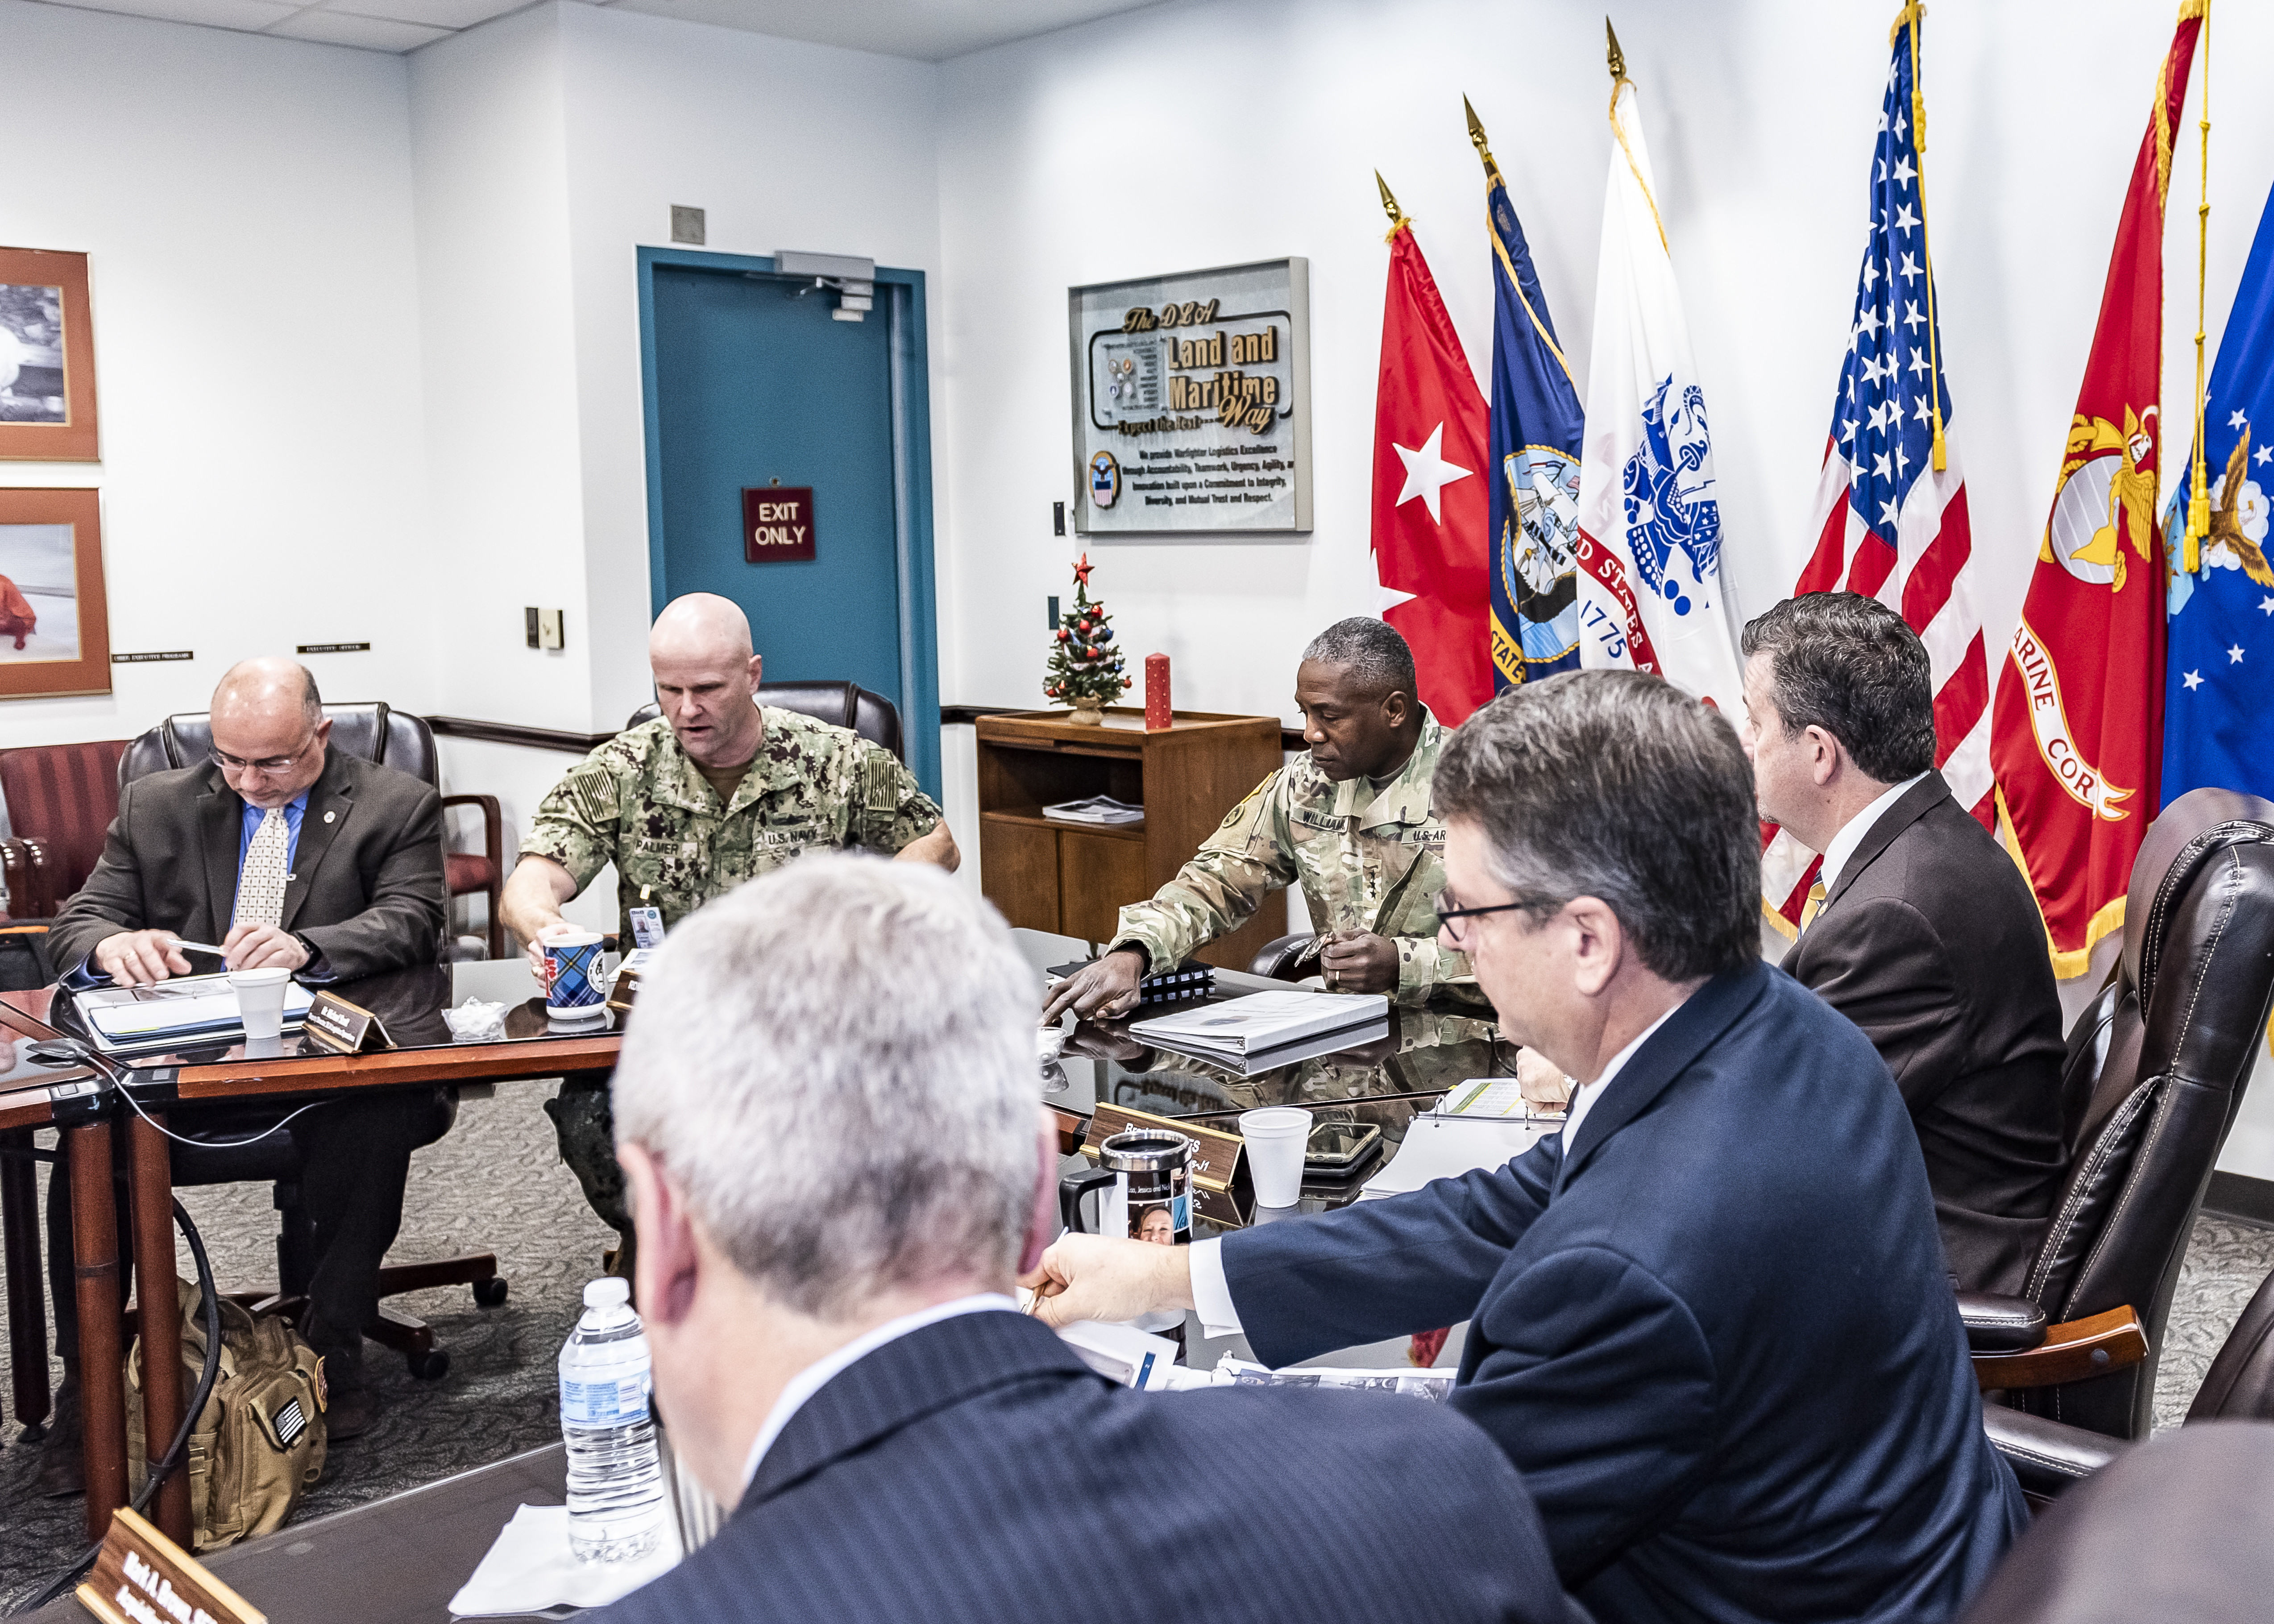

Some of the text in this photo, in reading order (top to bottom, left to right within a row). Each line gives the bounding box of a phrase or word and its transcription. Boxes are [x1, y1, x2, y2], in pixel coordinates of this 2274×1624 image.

[1123, 298, 1220, 334] The DLA
[1169, 326, 1278, 370] Land and
[1169, 370, 1278, 411] Maritime
[1219, 395, 1275, 435] Way
[759, 502, 800, 522] EXIT
[755, 526, 806, 546] ONLY
[1581, 600, 1627, 658] 1775
[636, 840, 679, 855] PALMER
[768, 829, 817, 845] U.S. NAVY
